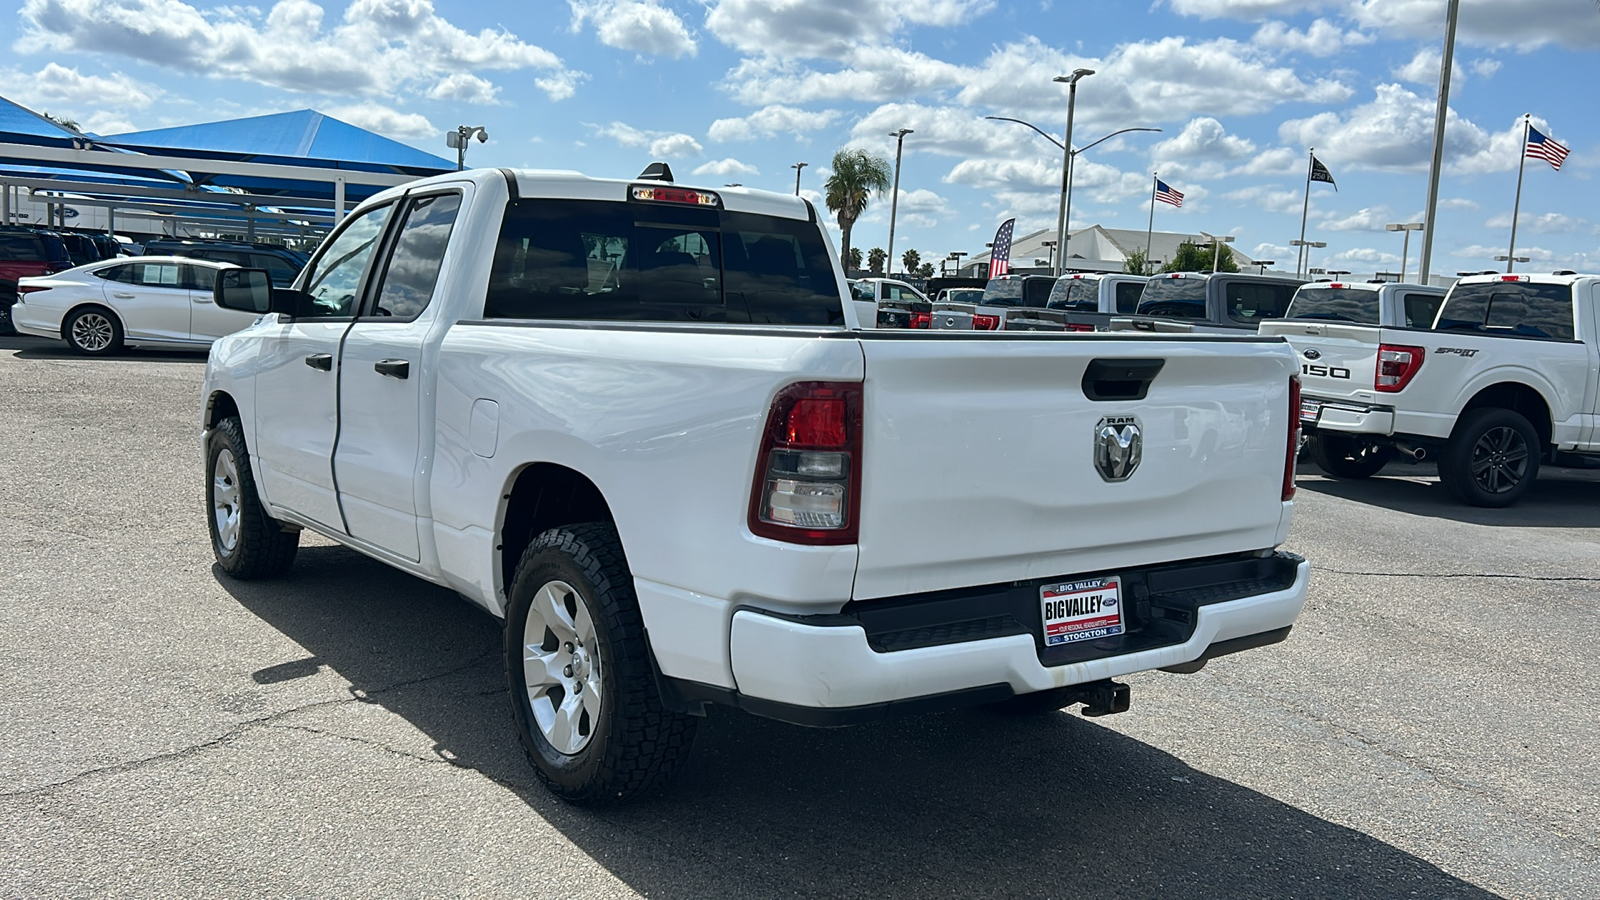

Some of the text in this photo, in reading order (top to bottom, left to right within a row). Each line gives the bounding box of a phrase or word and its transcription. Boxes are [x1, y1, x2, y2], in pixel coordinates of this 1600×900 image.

[1434, 347, 1480, 358] SPORT
[1074, 580, 1102, 589] VALLEY
[1045, 594, 1103, 620] BIGVALLEY
[1103, 598, 1116, 607] Ford
[1063, 628, 1107, 642] STOCKTON
